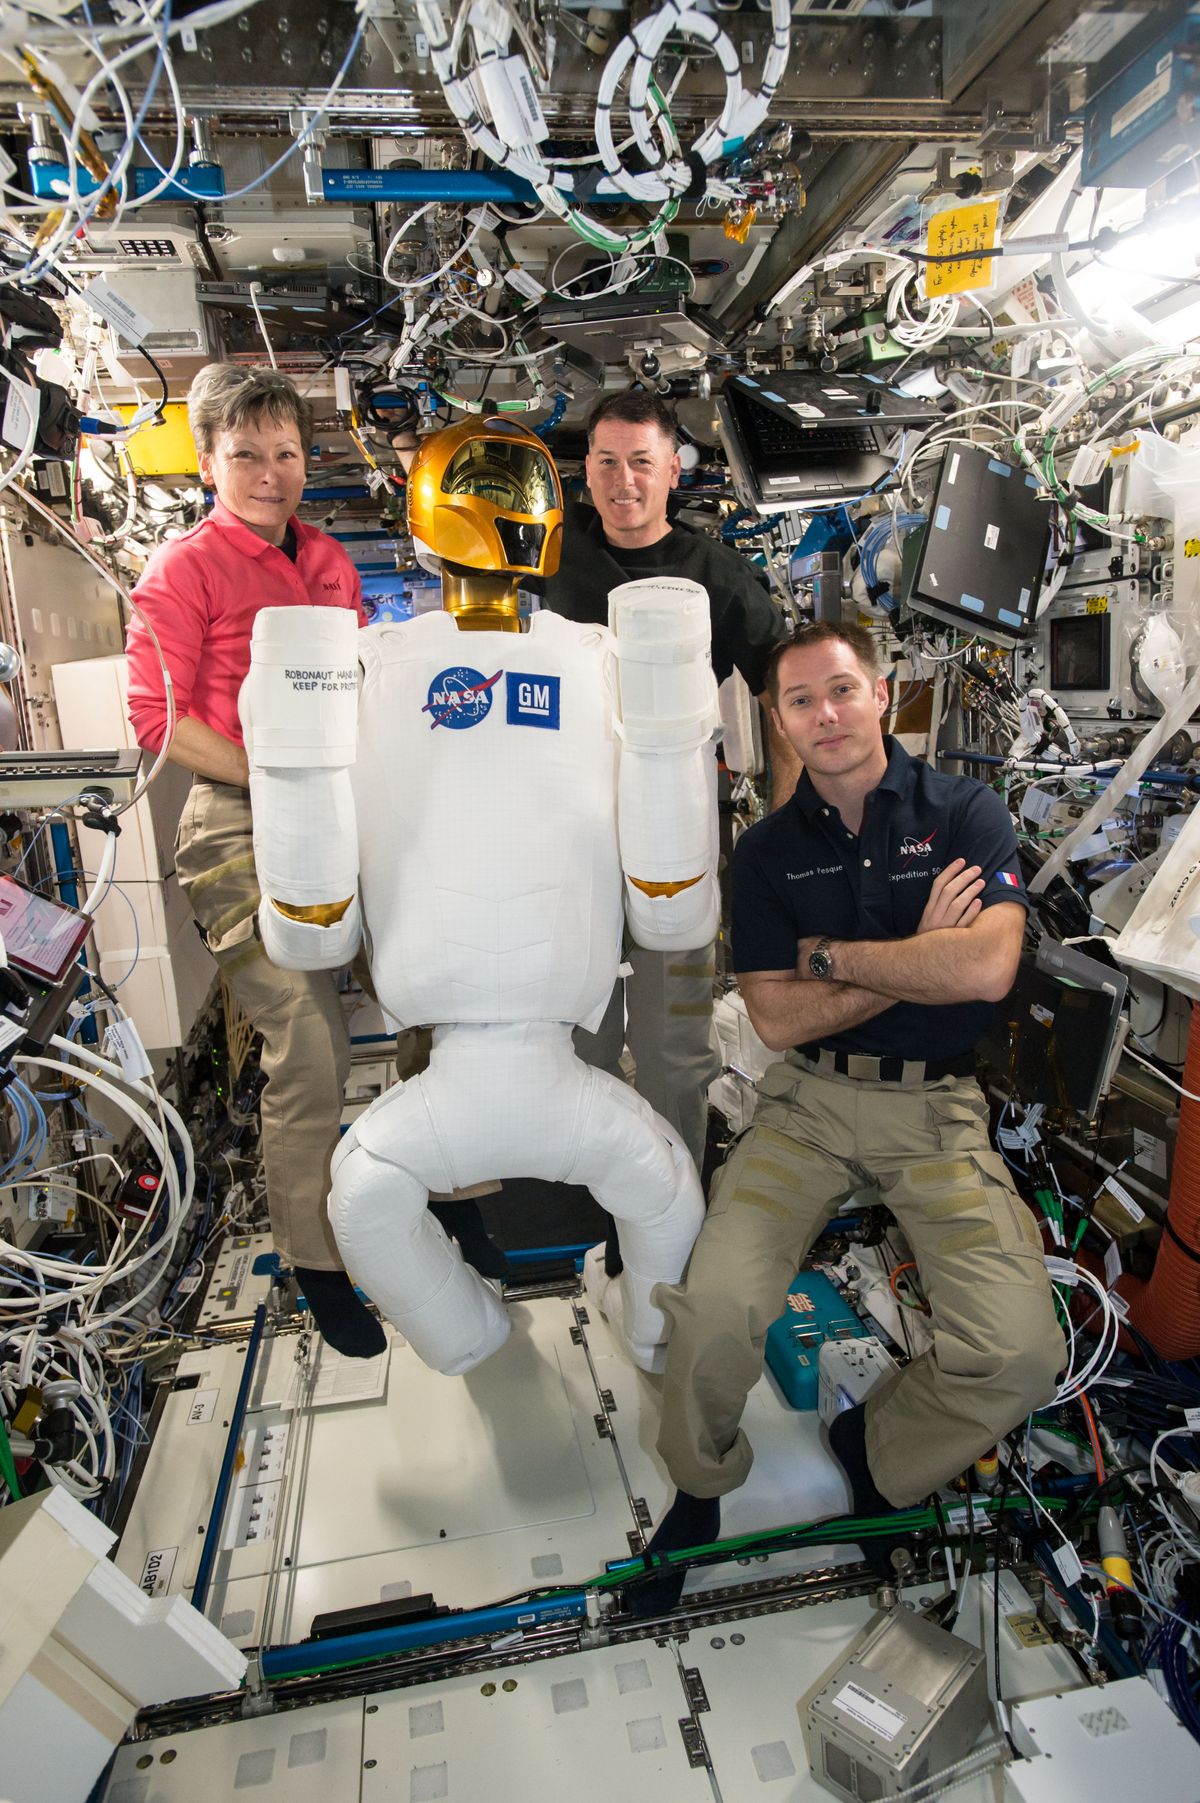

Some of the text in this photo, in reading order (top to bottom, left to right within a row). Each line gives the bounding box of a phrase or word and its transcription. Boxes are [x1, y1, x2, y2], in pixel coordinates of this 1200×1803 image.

[285, 670, 334, 681] ROBONAUT
[293, 681, 318, 692] KEEP
[321, 682, 339, 692] FOR
[432, 690, 490, 707] NASA
[519, 682, 550, 709] GM
[900, 842, 933, 856] NASA
[787, 870, 814, 881] Thomas
[1169, 876, 1189, 908] ZERO
[191, 1402, 205, 1420] AV-3
